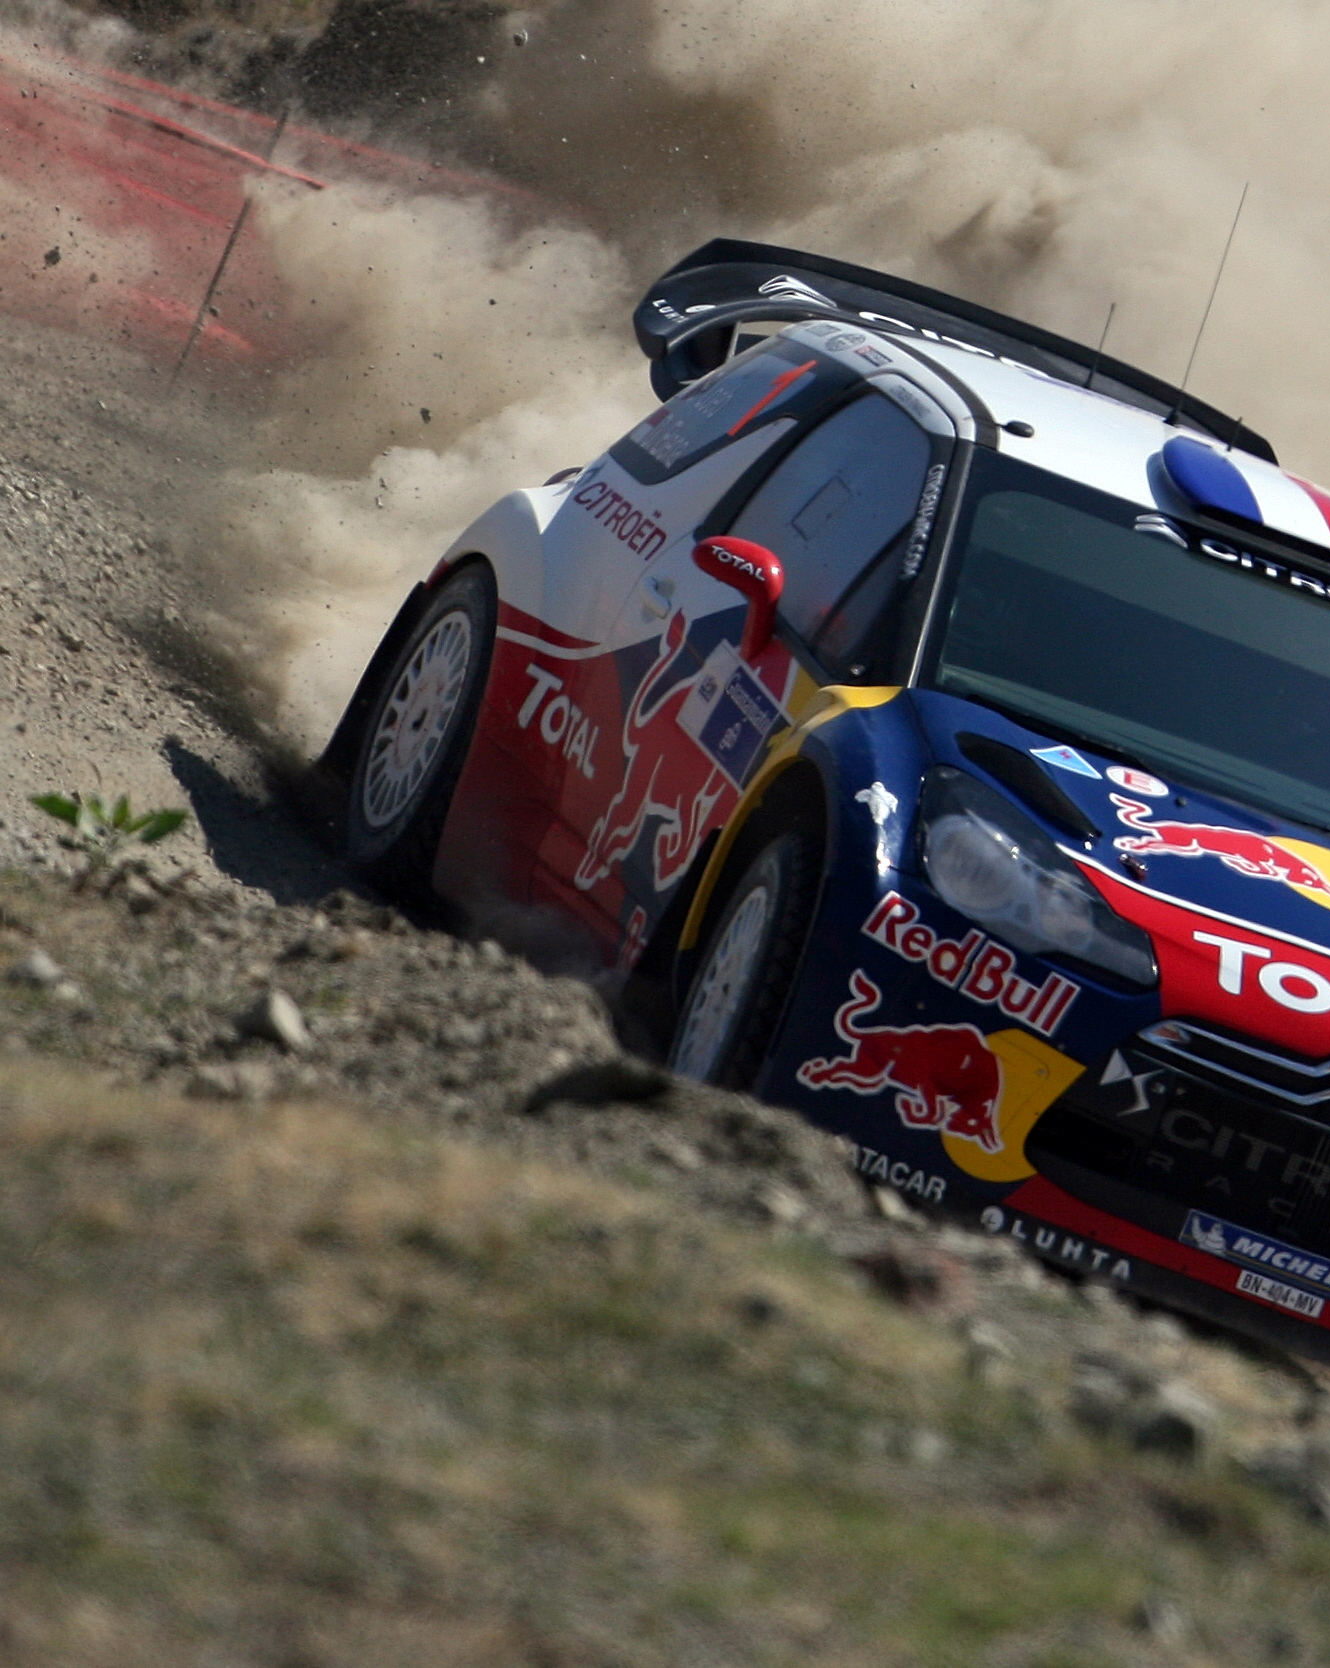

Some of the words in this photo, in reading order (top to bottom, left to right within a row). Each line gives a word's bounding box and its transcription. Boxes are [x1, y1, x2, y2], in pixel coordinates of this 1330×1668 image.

[711, 544, 766, 582] TOTAL
[518, 663, 600, 780] TOTAL
[1010, 1218, 1132, 1282] LUHTA
